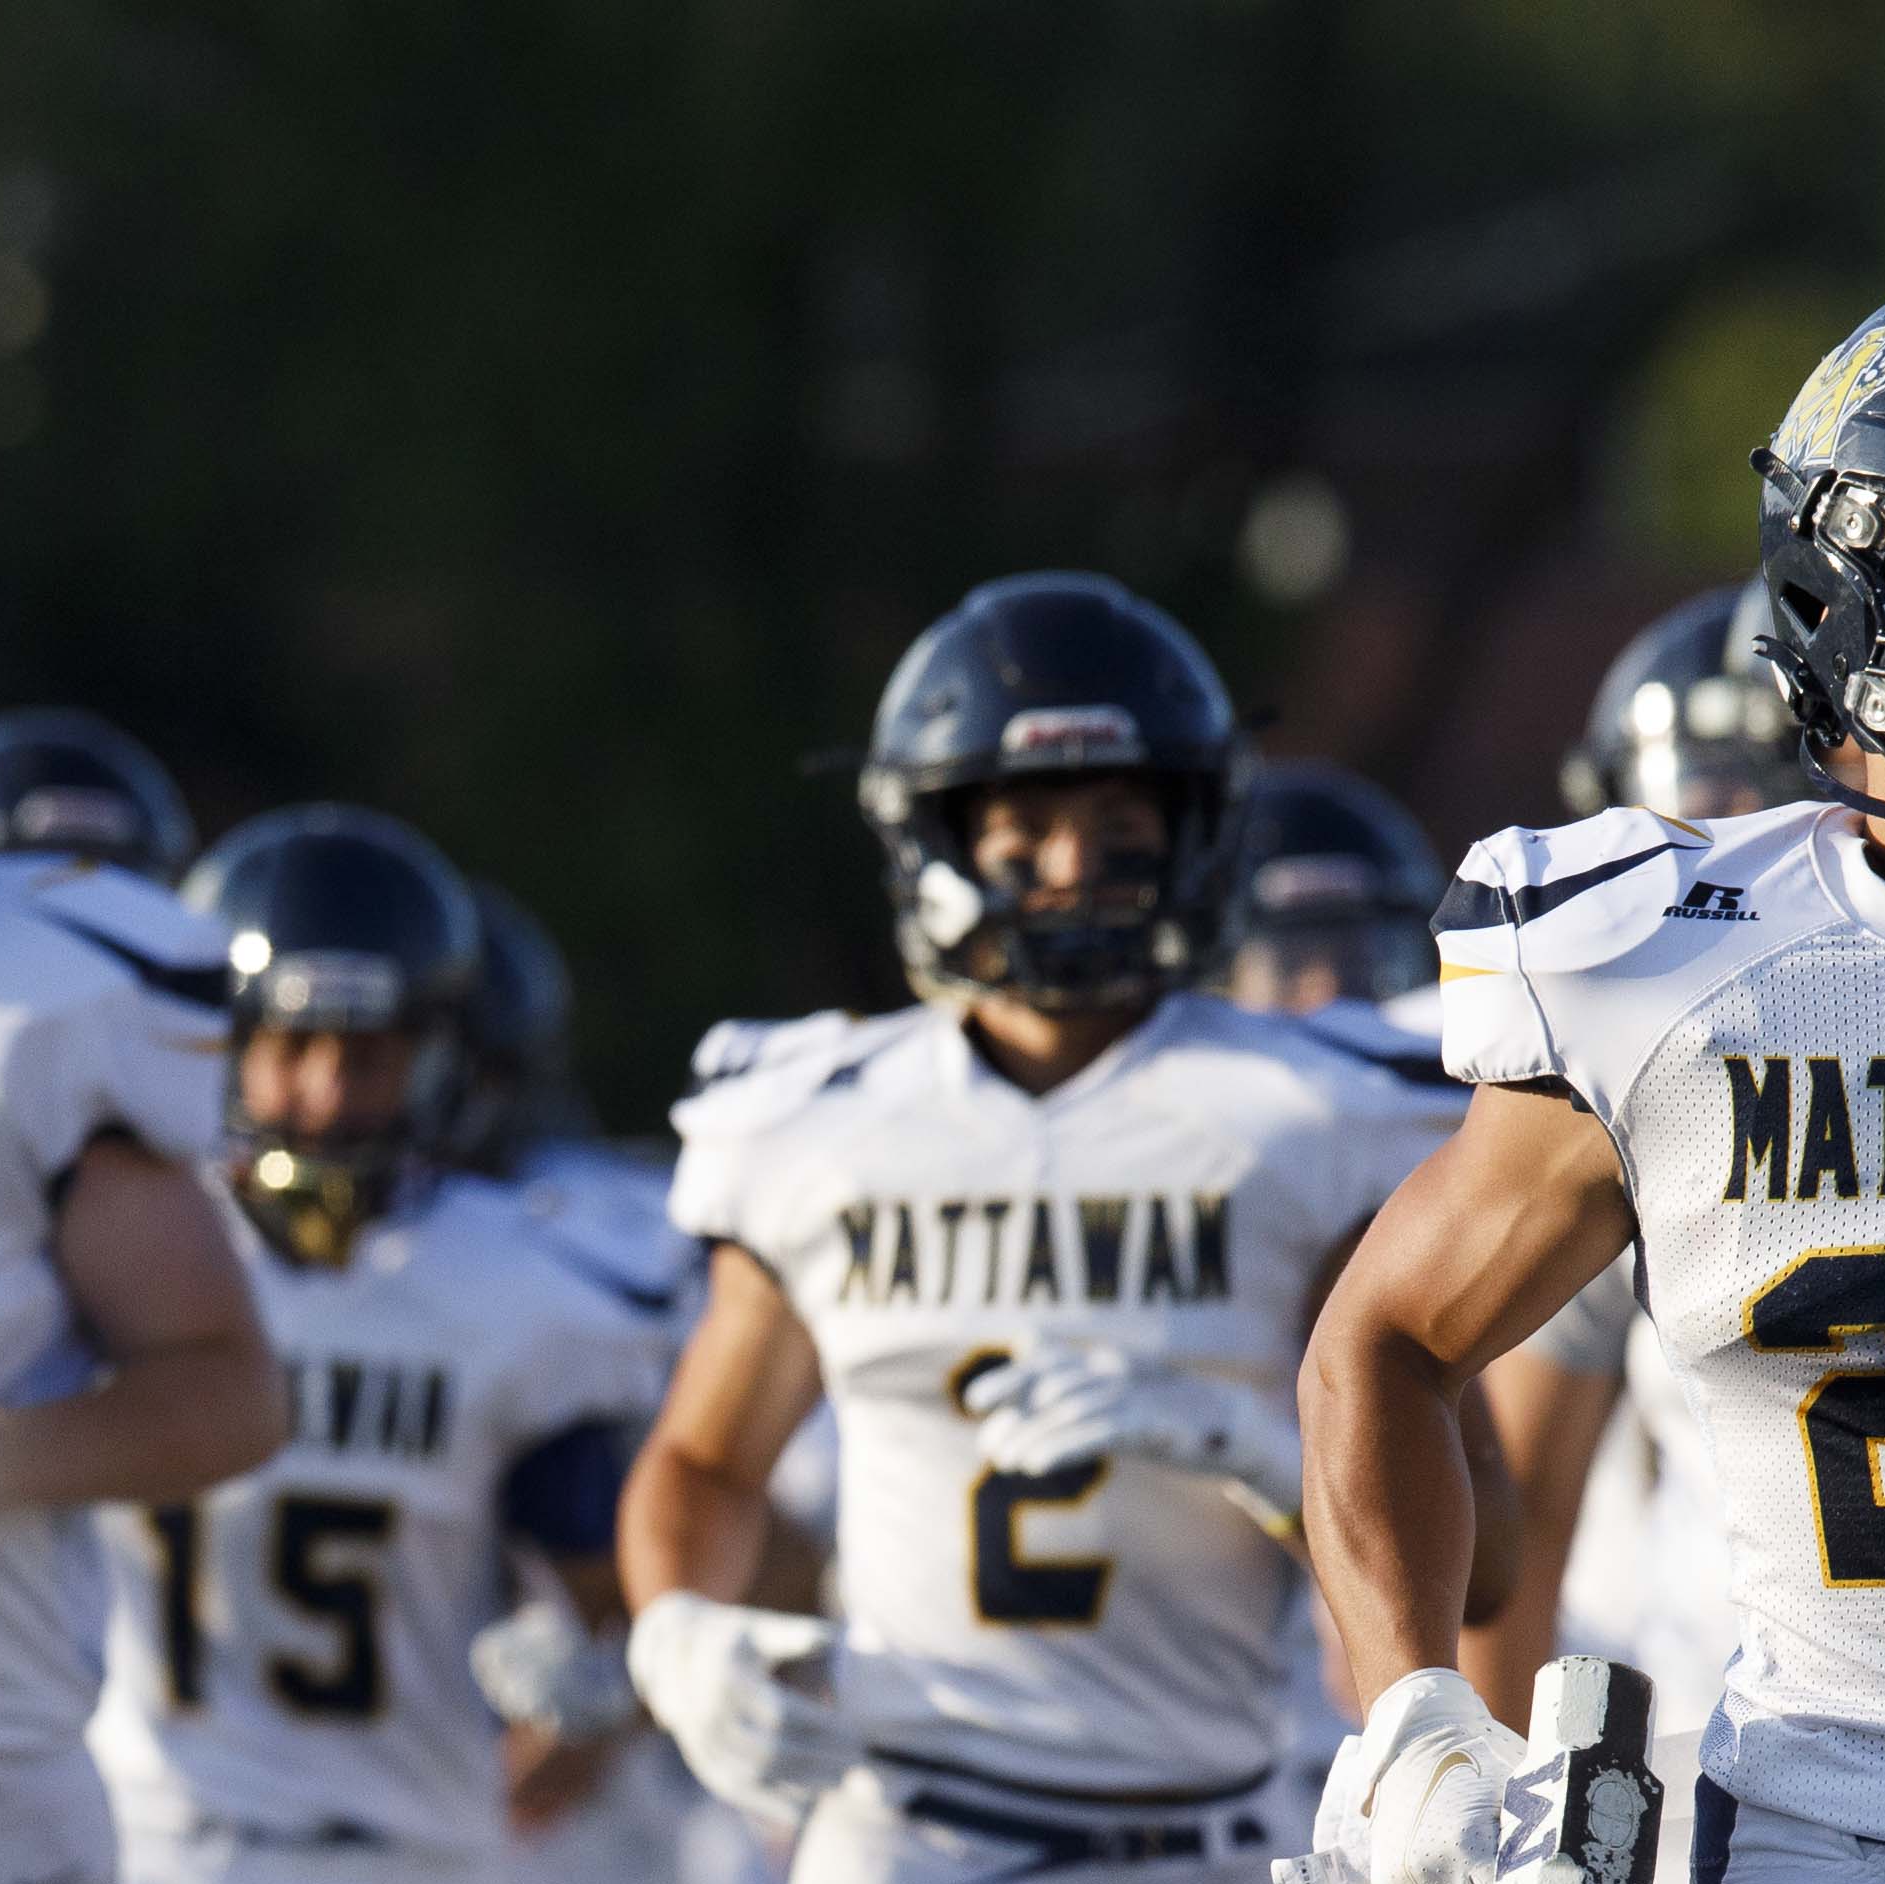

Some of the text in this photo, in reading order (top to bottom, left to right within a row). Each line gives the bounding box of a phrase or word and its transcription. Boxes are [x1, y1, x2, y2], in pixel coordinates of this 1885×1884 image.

[1661, 905, 1762, 921] RUSSELL
[832, 1194, 1233, 1308] MATTAWAN
[142, 1488, 398, 1724] 15
